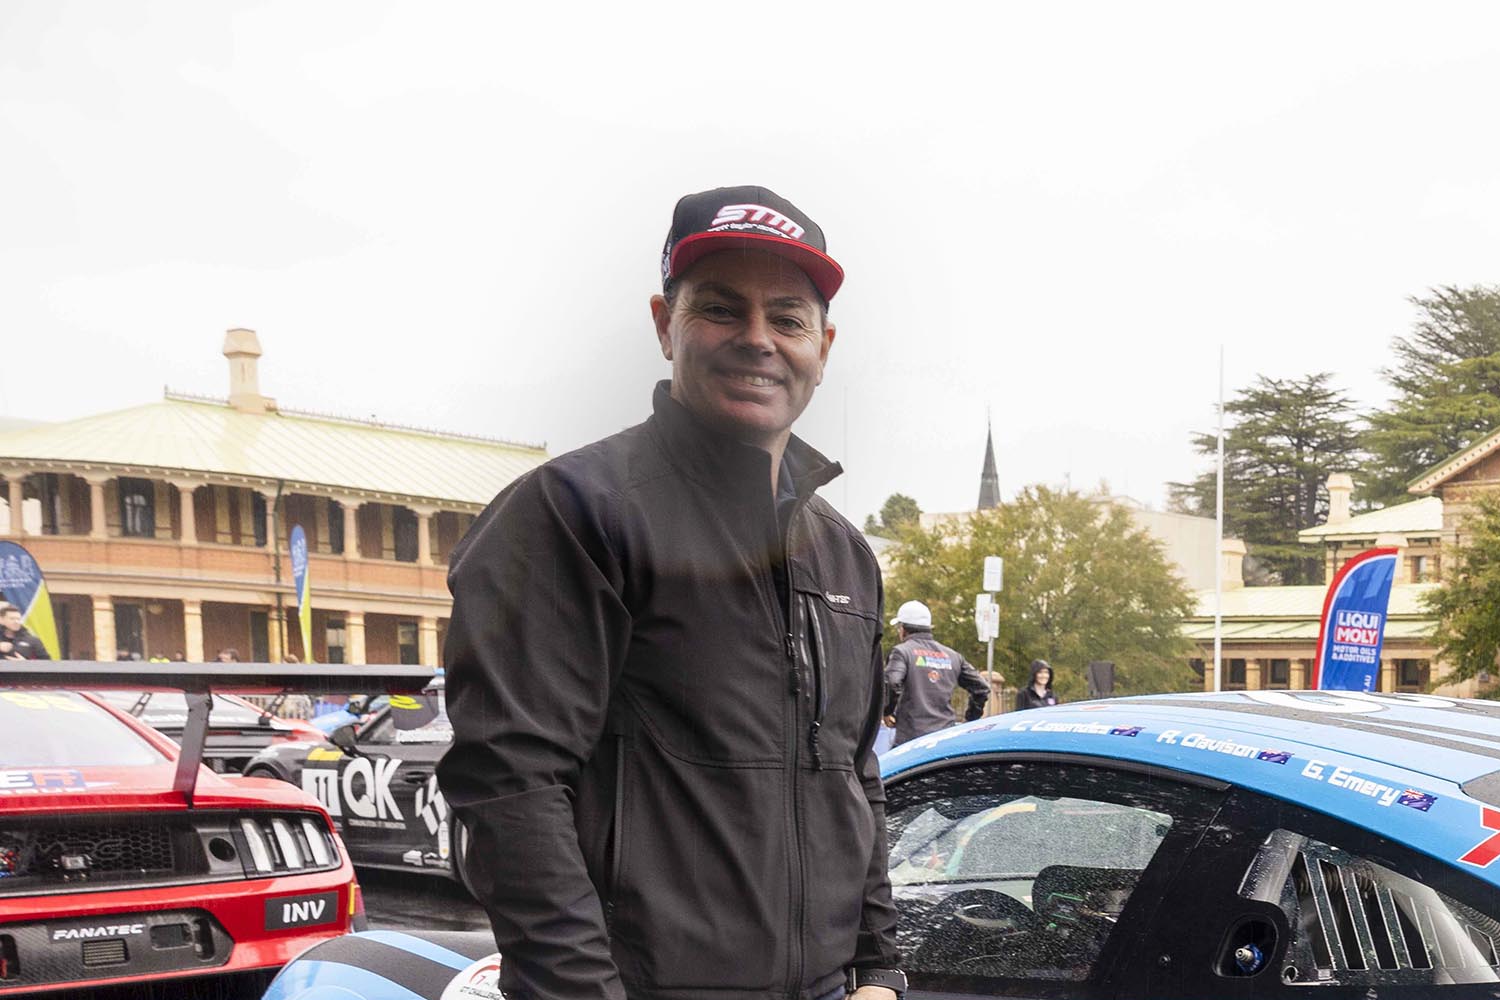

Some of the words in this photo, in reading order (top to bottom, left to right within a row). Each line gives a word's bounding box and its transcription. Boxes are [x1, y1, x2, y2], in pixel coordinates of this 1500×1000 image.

[711, 203, 805, 239] STM
[1338, 612, 1379, 629] LIQUI
[1336, 627, 1378, 645] MOLY
[1332, 645, 1359, 654] MOTOR
[1360, 647, 1377, 656] OILS
[1181, 732, 1260, 759] Davison
[342, 756, 405, 821] QK
[1301, 759, 1327, 781] G.
[1327, 766, 1402, 807] Emery
[282, 899, 326, 923] INV
[53, 924, 145, 940] FANATEC
